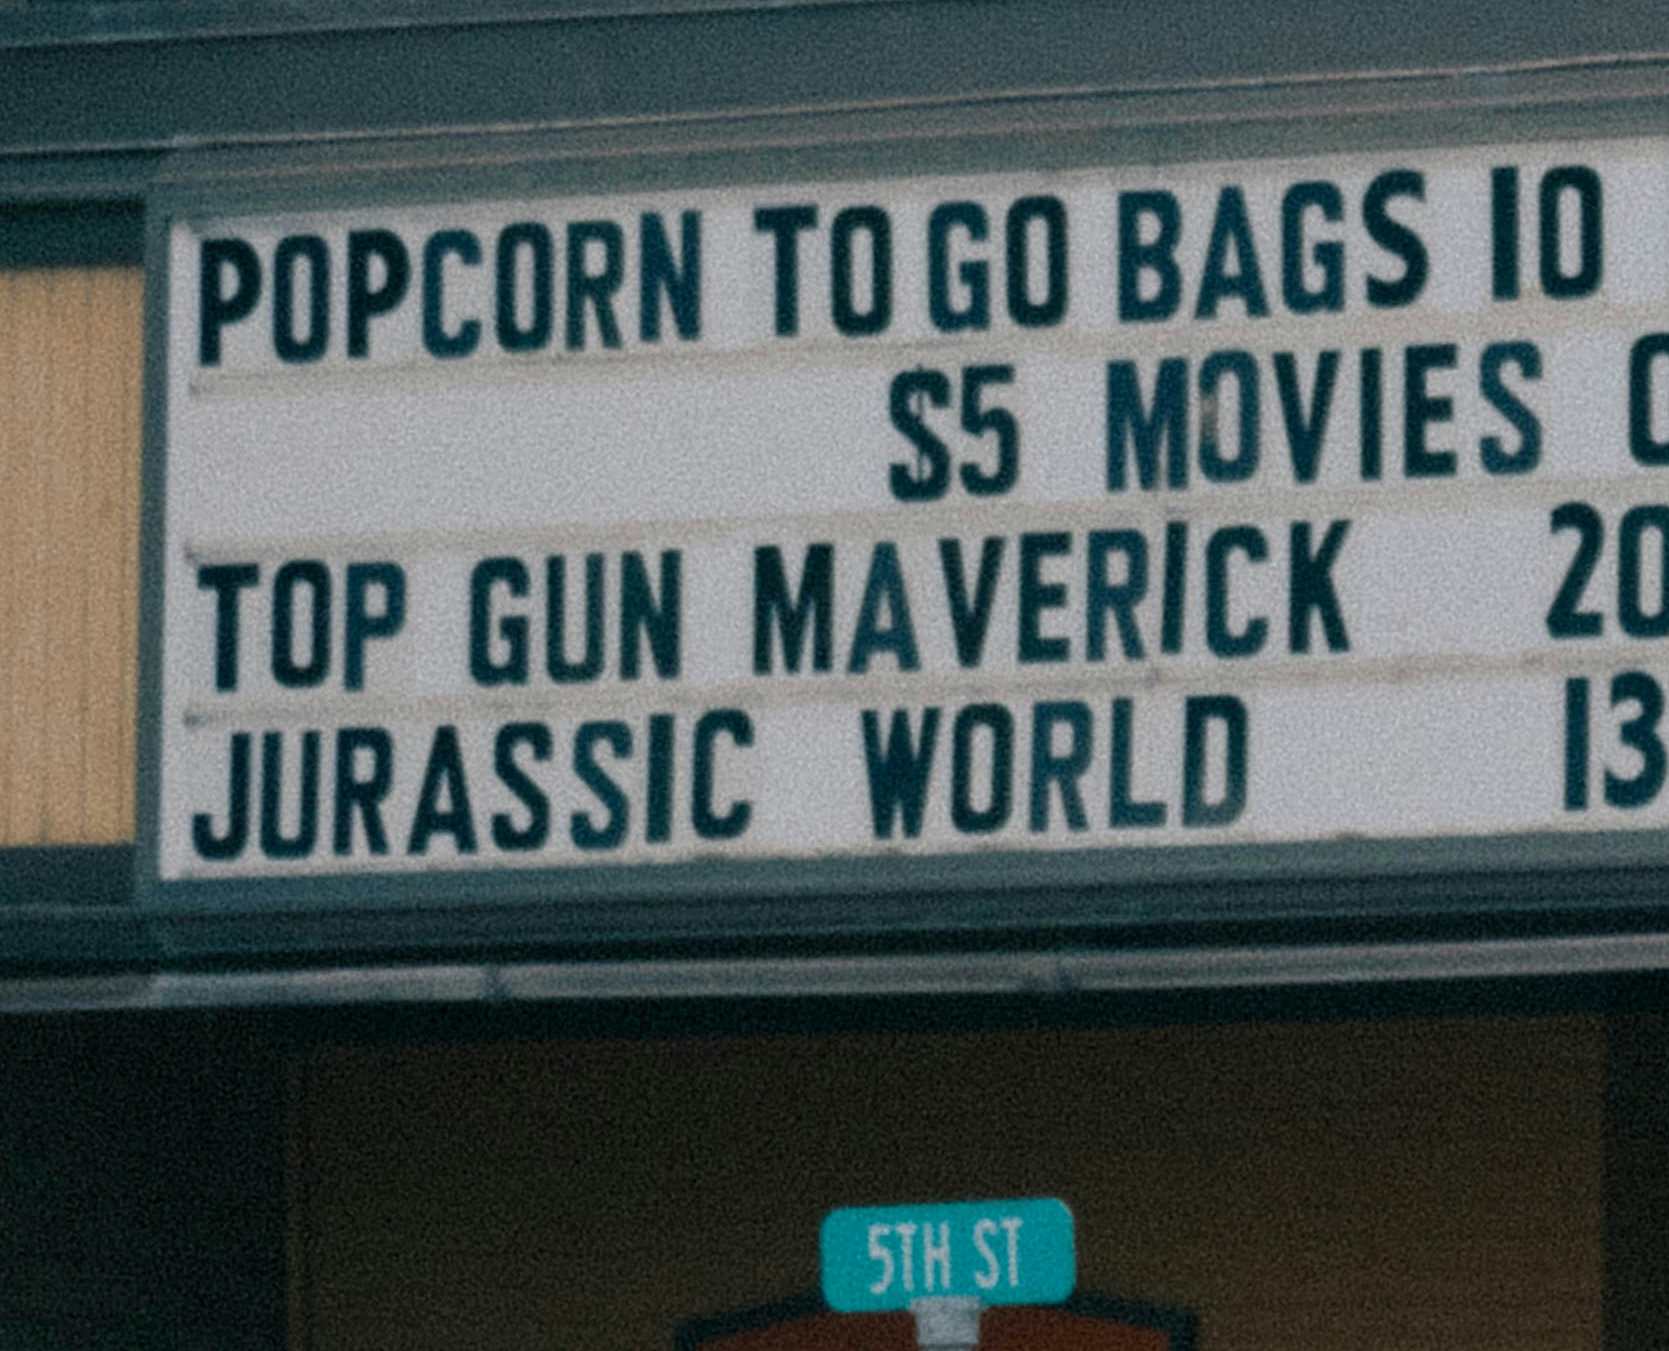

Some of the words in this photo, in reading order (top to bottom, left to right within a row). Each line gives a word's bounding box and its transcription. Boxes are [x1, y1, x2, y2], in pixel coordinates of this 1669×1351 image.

[196, 206, 702, 368] POPCORN
[752, 201, 894, 339] TO
[926, 192, 1070, 334] GO
[1117, 164, 1430, 324] BAGS
[1490, 162, 1604, 302] 10
[888, 361, 1021, 504] $5
[1106, 340, 1543, 493] MOVIES
[195, 557, 408, 693] TOP
[468, 548, 682, 689] GUN
[752, 518, 1351, 676] MAVERICK
[191, 706, 755, 863] JURASSIC
[860, 692, 1249, 841] WORLD
[868, 1224, 950, 1294] 5TH
[973, 1218, 1023, 1289] ST
